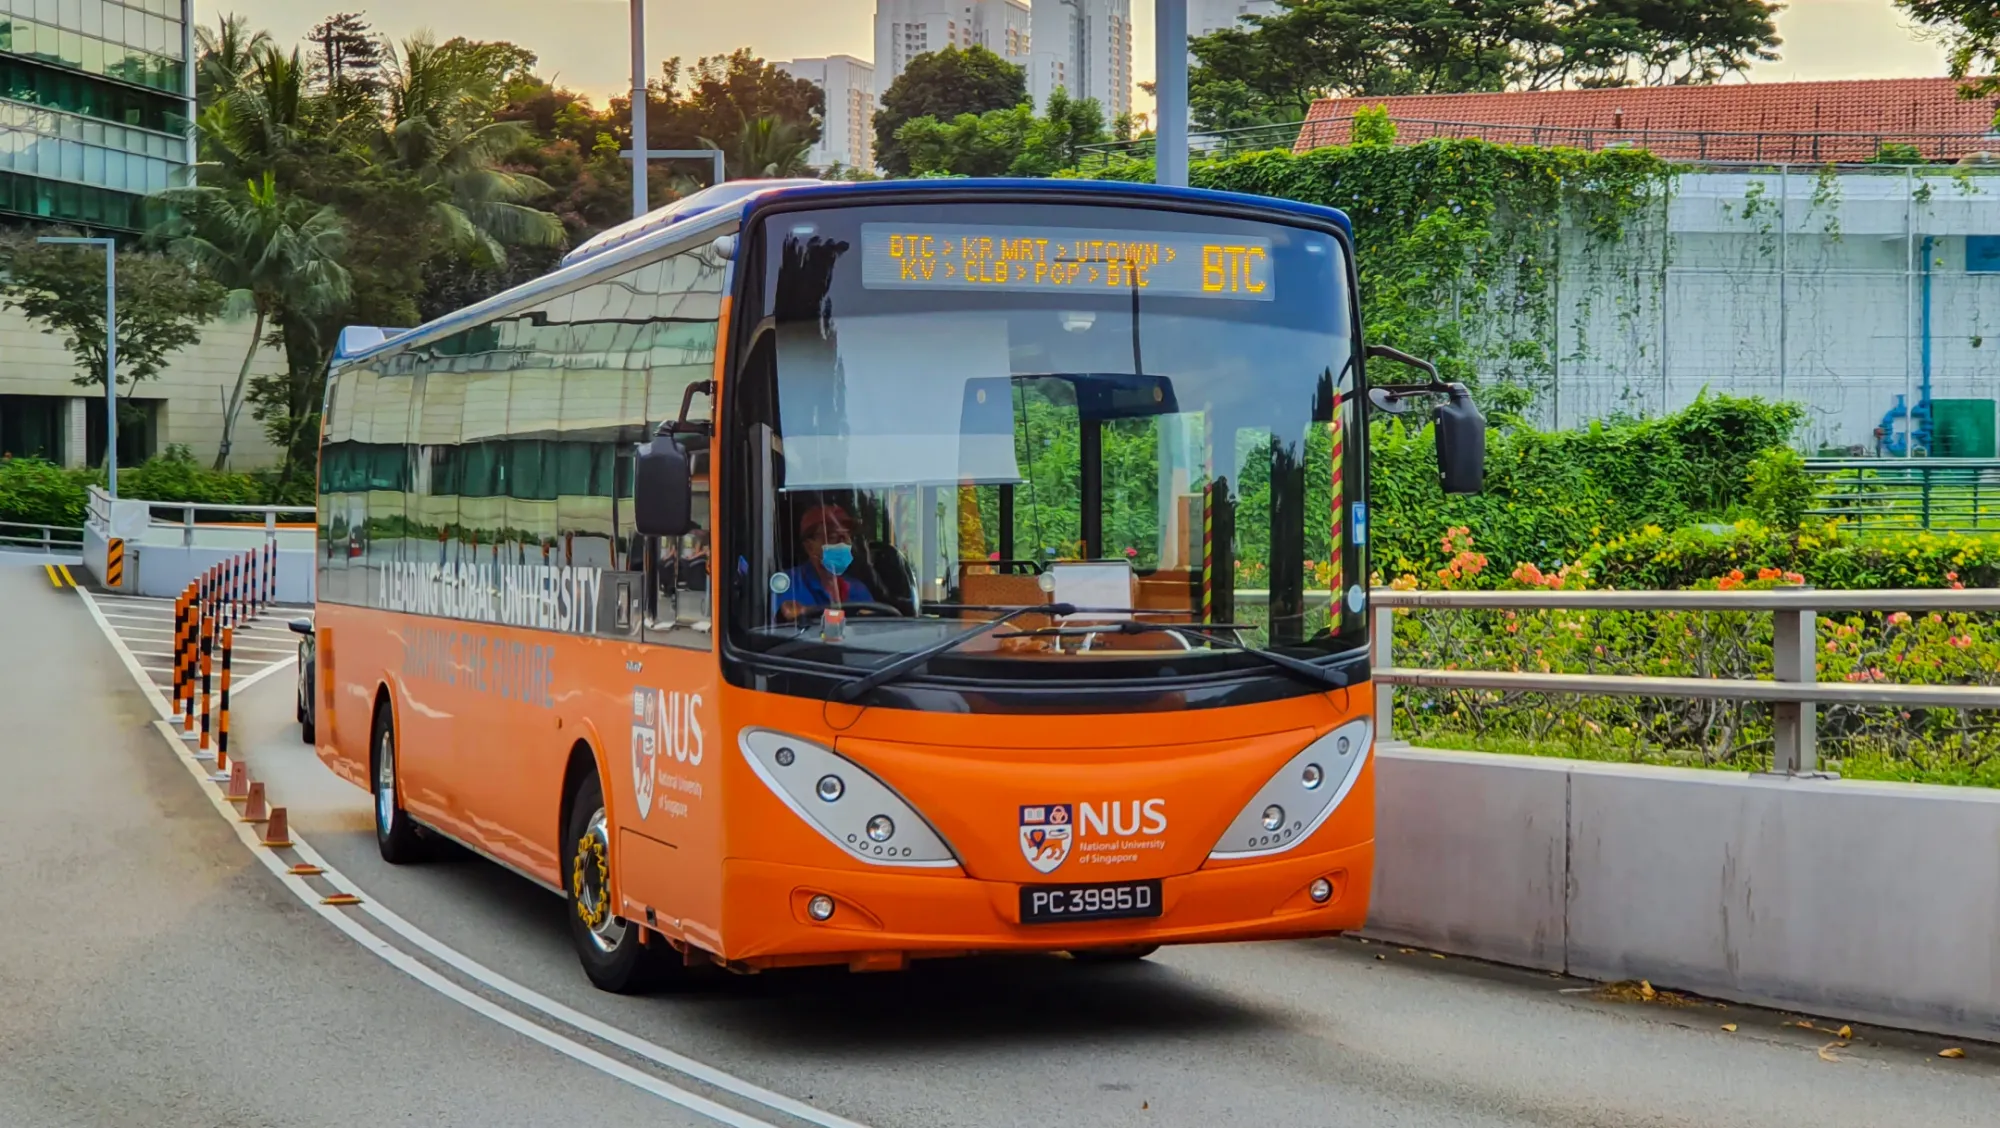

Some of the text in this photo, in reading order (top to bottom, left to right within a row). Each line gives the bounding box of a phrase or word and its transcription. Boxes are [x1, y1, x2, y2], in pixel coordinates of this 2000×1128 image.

[889, 233, 1160, 265] BTC KR MRT UTOWN
[901, 257, 1149, 287] KV CLB PGP BTC
[1202, 244, 1266, 293] BTC
[378, 560, 602, 634] A LEADING GLOBAL UNIVERSITY
[462, 632, 487, 693] THE
[494, 638, 556, 709] FUTURE
[658, 688, 703, 766] NUS
[1079, 798, 1168, 837] NUS
[1079, 839, 1166, 851] National University
[1079, 853, 1138, 865] of Singapore
[1032, 891, 1065, 915] PC
